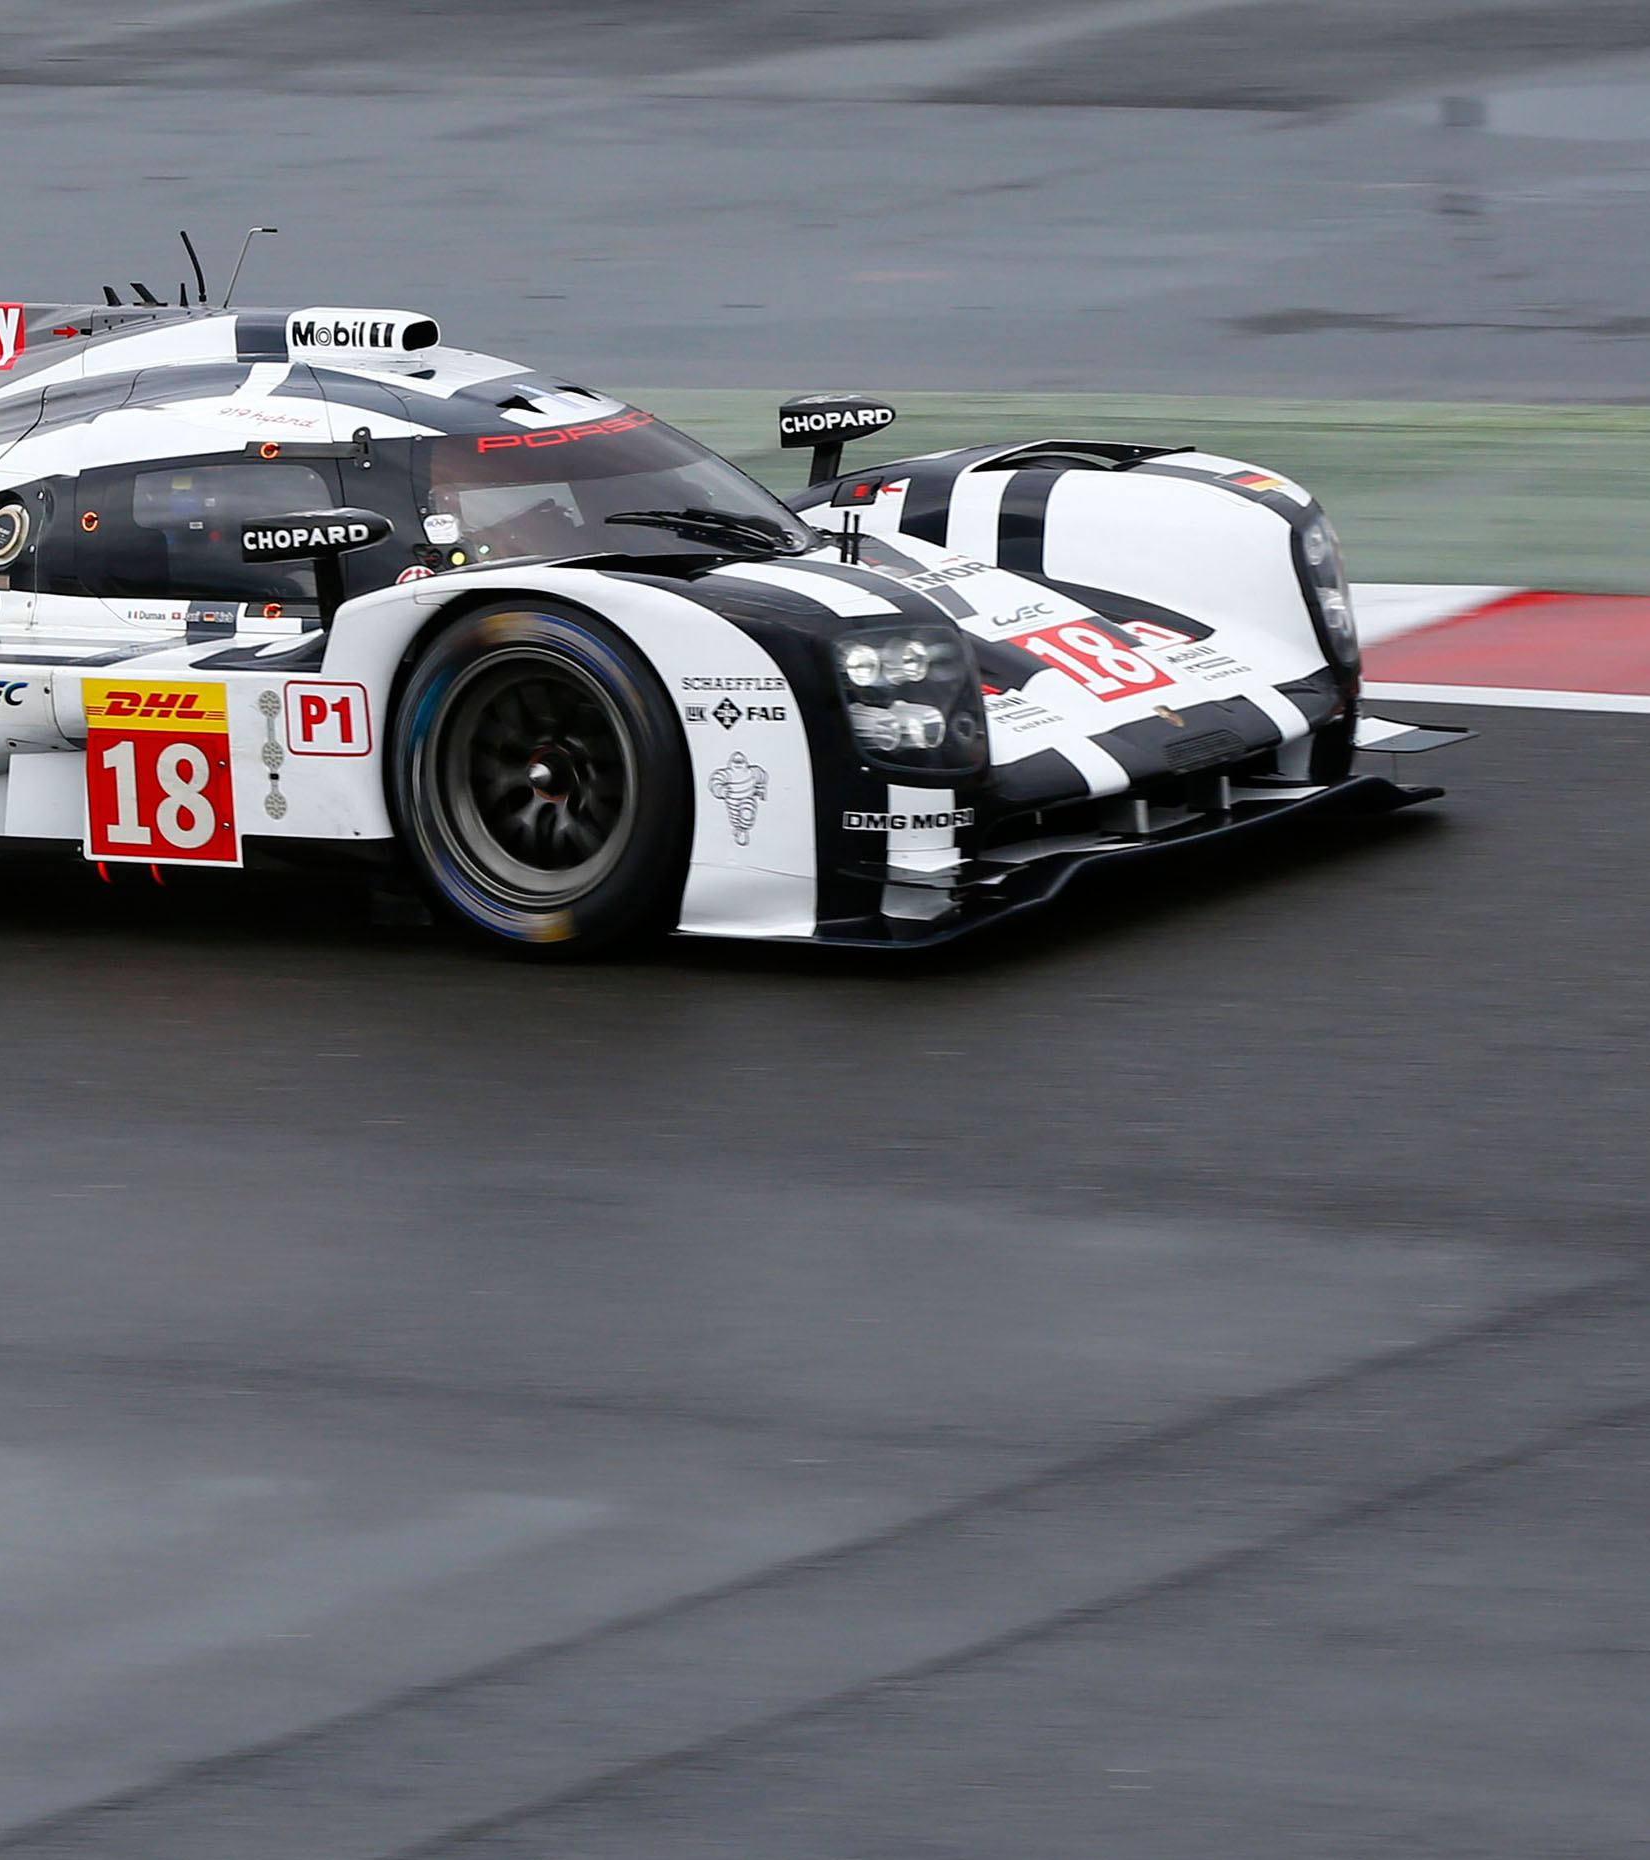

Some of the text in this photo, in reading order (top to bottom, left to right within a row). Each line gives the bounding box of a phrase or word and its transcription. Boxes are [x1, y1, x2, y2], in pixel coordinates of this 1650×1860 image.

[292, 321, 366, 347] Mobil
[217, 407, 321, 428] 919 hybrid
[781, 408, 893, 434] CHOPARD
[243, 524, 369, 550] CHOPARD
[993, 603, 1054, 626] WEC
[1025, 626, 1157, 696] 18
[682, 677, 786, 691] SCHAEFFLER
[105, 691, 208, 720] DHL
[746, 706, 787, 721] FAG
[300, 695, 353, 743] P1
[102, 740, 216, 850] 18
[849, 813, 907, 830] DMG
